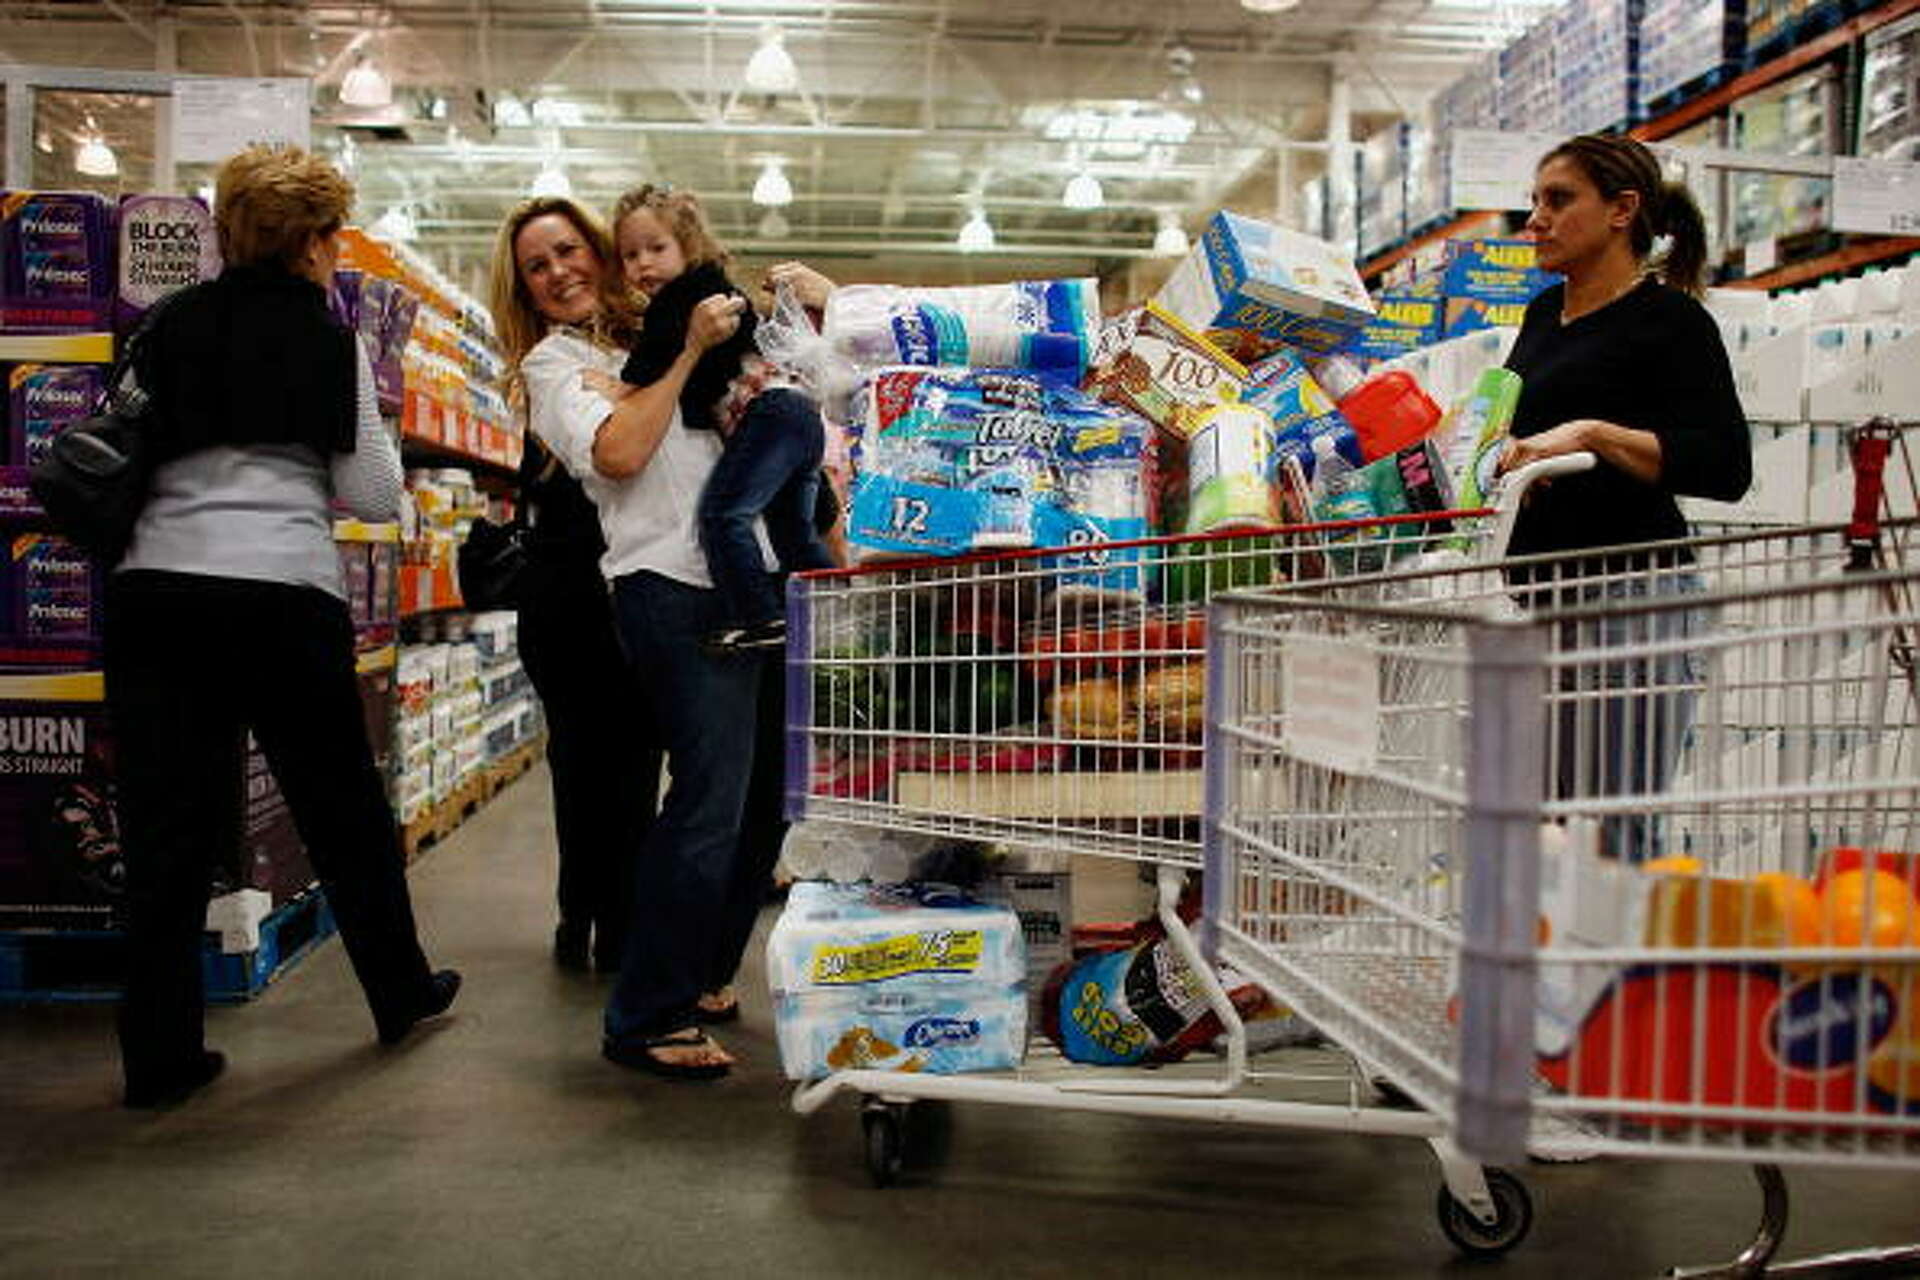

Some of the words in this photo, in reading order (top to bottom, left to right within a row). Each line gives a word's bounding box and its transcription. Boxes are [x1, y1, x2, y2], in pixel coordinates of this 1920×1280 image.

[129, 222, 199, 240] BLOCK
[893, 496, 929, 533] 12
[0, 716, 85, 754] BURN
[15, 756, 83, 774] STRAIGHT
